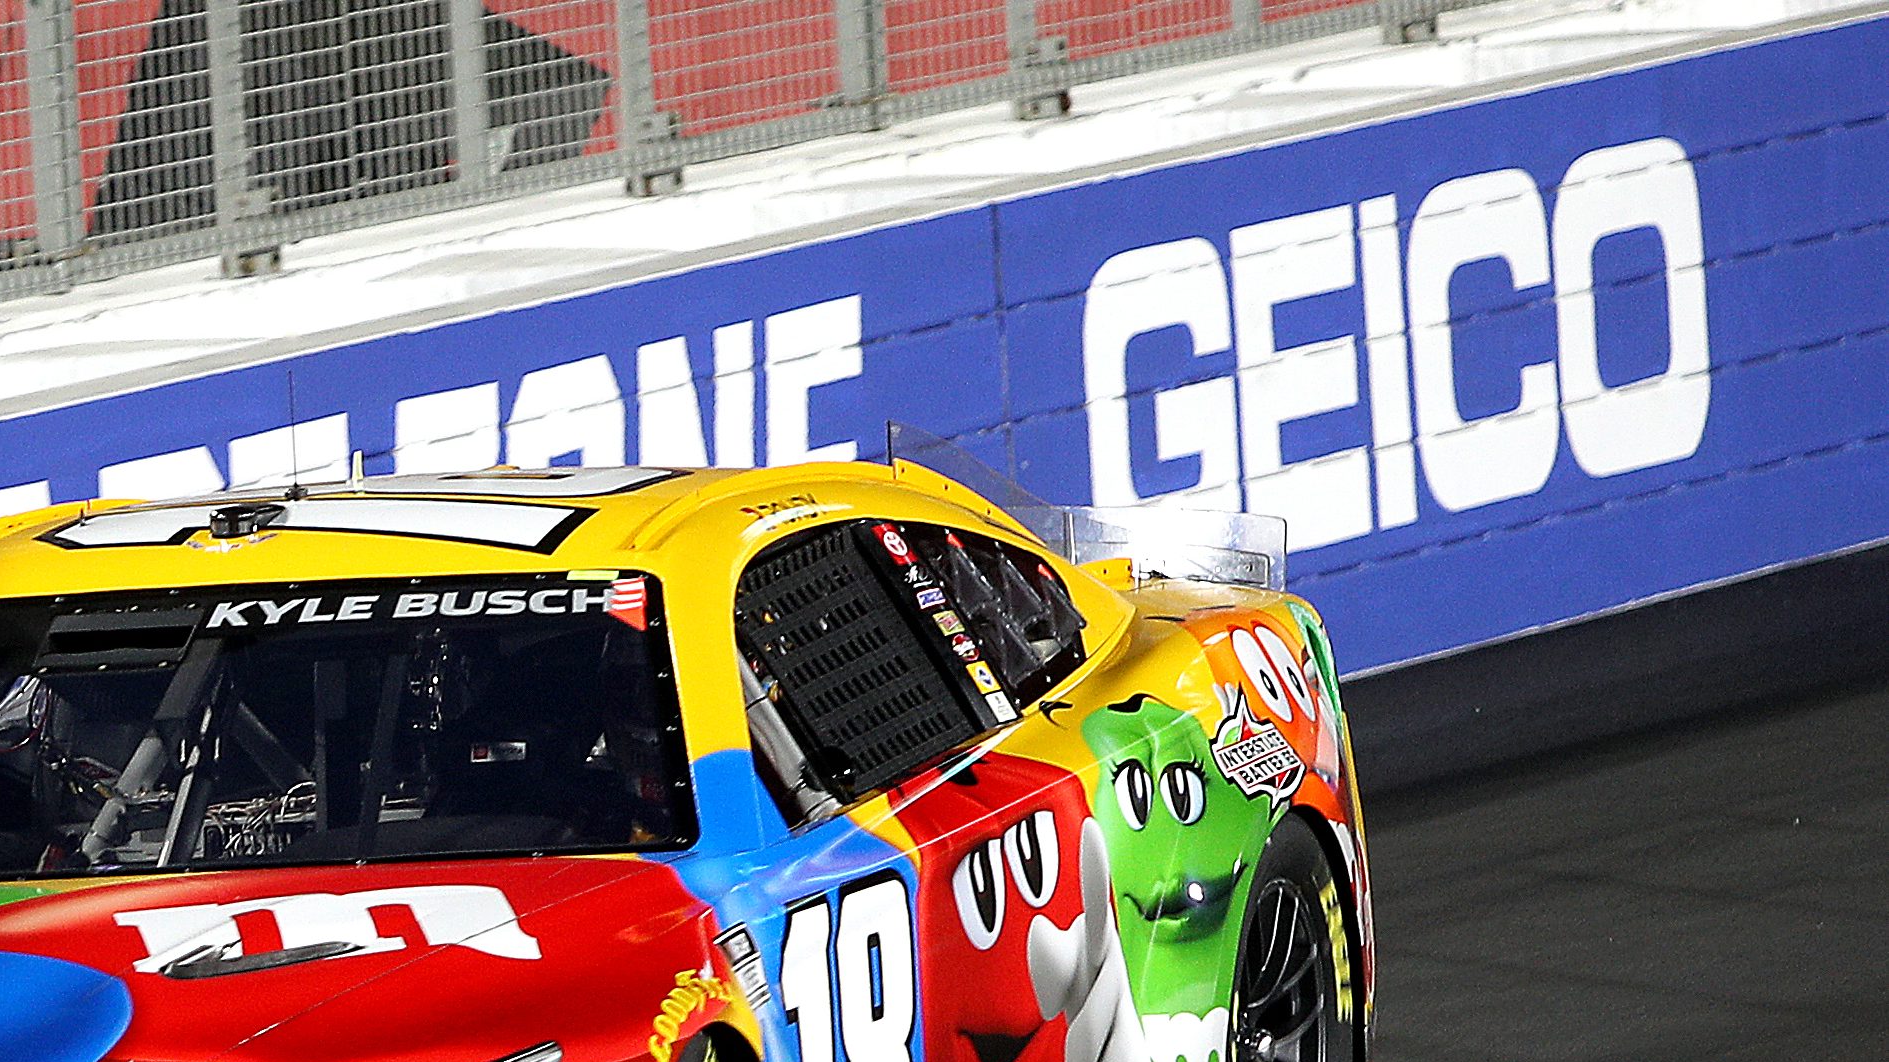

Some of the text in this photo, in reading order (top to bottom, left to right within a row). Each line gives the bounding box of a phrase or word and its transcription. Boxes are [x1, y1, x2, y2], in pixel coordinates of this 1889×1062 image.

[1083, 137, 1710, 560] GEICO
[206, 587, 616, 629] KYLE BUSCH
[113, 885, 542, 972] m
